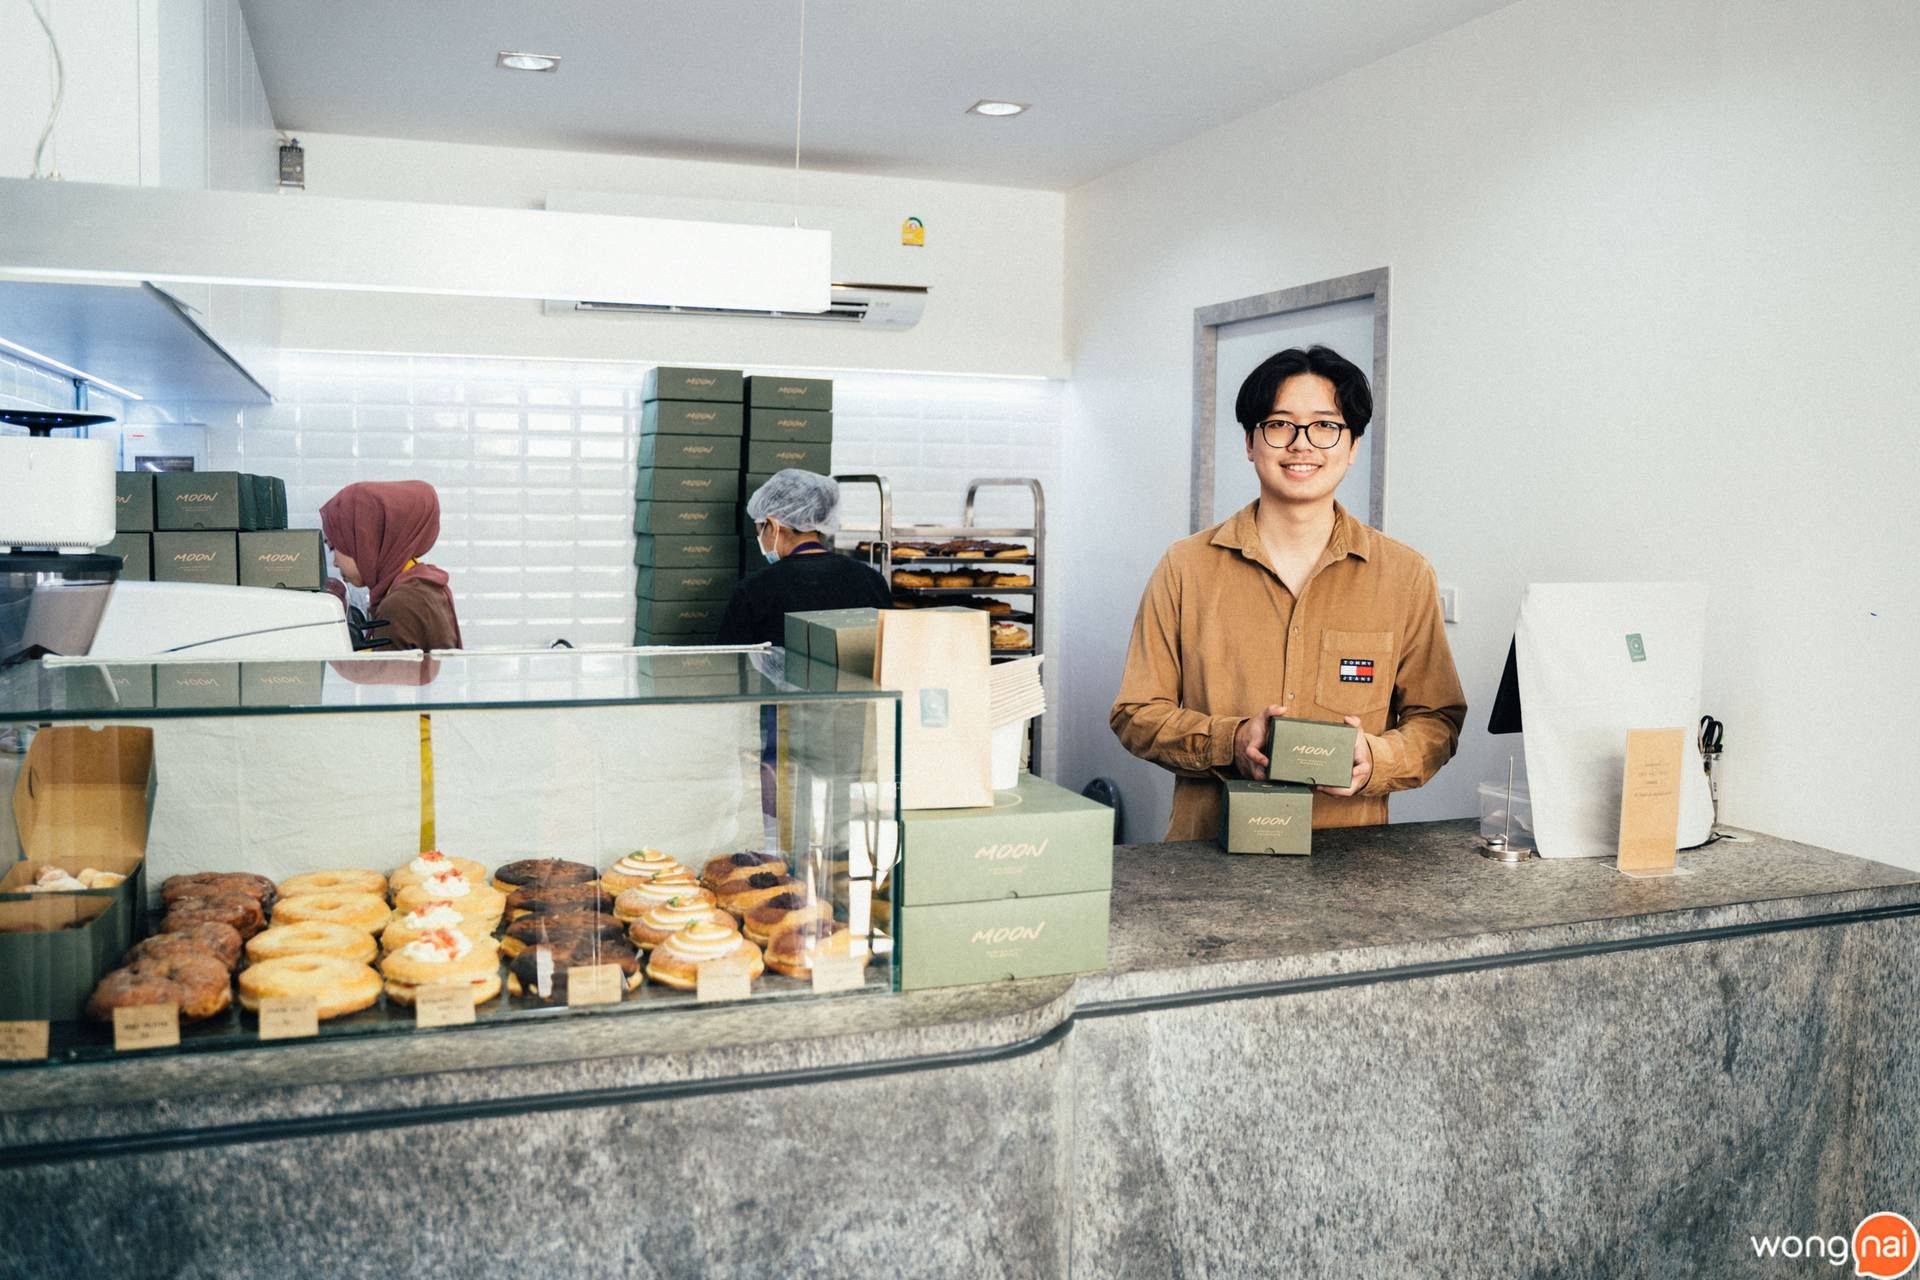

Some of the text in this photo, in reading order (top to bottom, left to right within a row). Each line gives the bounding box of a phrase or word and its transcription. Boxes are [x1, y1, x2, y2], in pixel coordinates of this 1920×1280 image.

[685, 378, 717, 386] MOON
[777, 386, 808, 395] MOON
[684, 411, 717, 421] MOON
[776, 419, 808, 428] MOON
[682, 445, 714, 454] MOON
[775, 451, 807, 460] MOON
[680, 478, 712, 488] MOON
[175, 492, 219, 502] MOON
[677, 512, 709, 521] MOON
[682, 544, 713, 554] MOON
[174, 552, 217, 562] MOON
[258, 552, 300, 562] MOON
[1292, 745, 1336, 757] MOON
[1248, 816, 1292, 826] MOON
[974, 838, 1049, 860] MOON
[971, 921, 1045, 944] MOON
